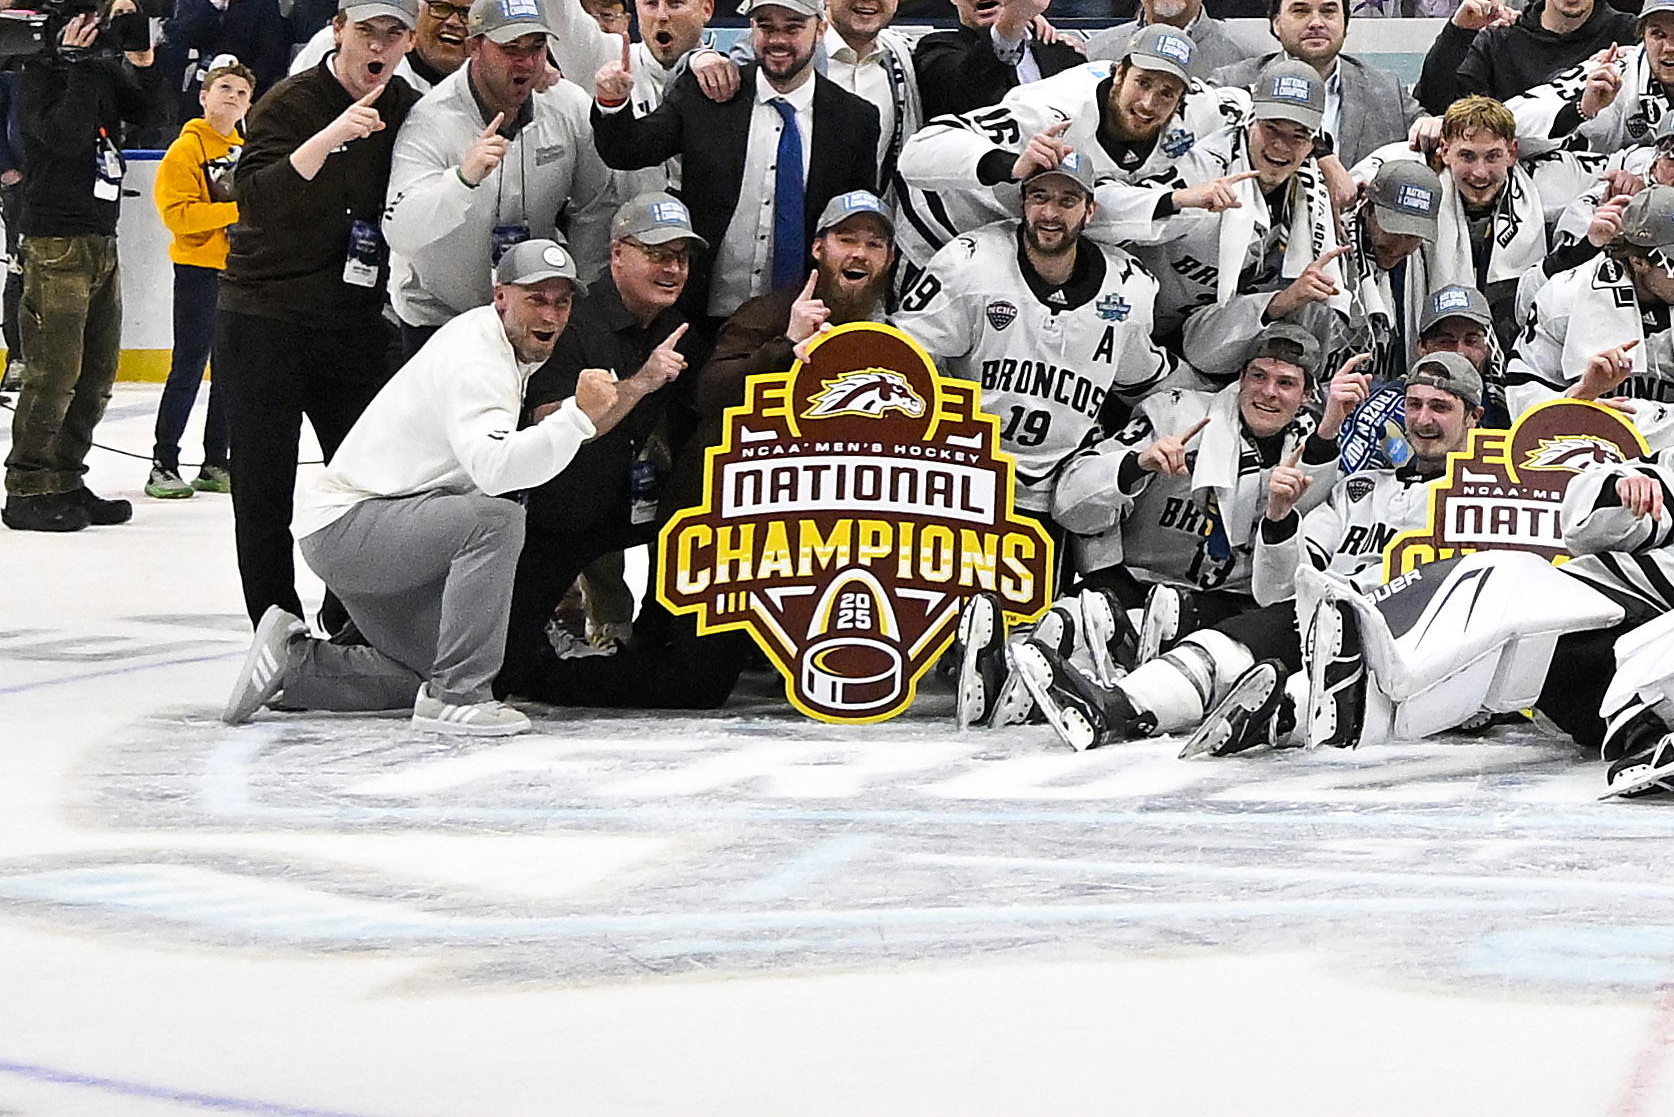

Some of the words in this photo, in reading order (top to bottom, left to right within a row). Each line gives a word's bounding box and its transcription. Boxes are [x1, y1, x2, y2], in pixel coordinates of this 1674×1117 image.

[987, 305, 1018, 317] NCHC
[1092, 325, 1115, 364] A
[982, 358, 1106, 423] BRONCOS
[998, 404, 1052, 447] 19
[742, 442, 801, 458] NCAA
[815, 442, 883, 454] MEN'S
[893, 442, 981, 464] HOCKEY
[734, 463, 986, 515] NATIONAL
[1463, 486, 1519, 497] NCAA
[1455, 505, 1562, 540] NATI
[677, 518, 1038, 604] CHAMPIONS
[840, 592, 871, 609] 20
[836, 609, 872, 630] 25
